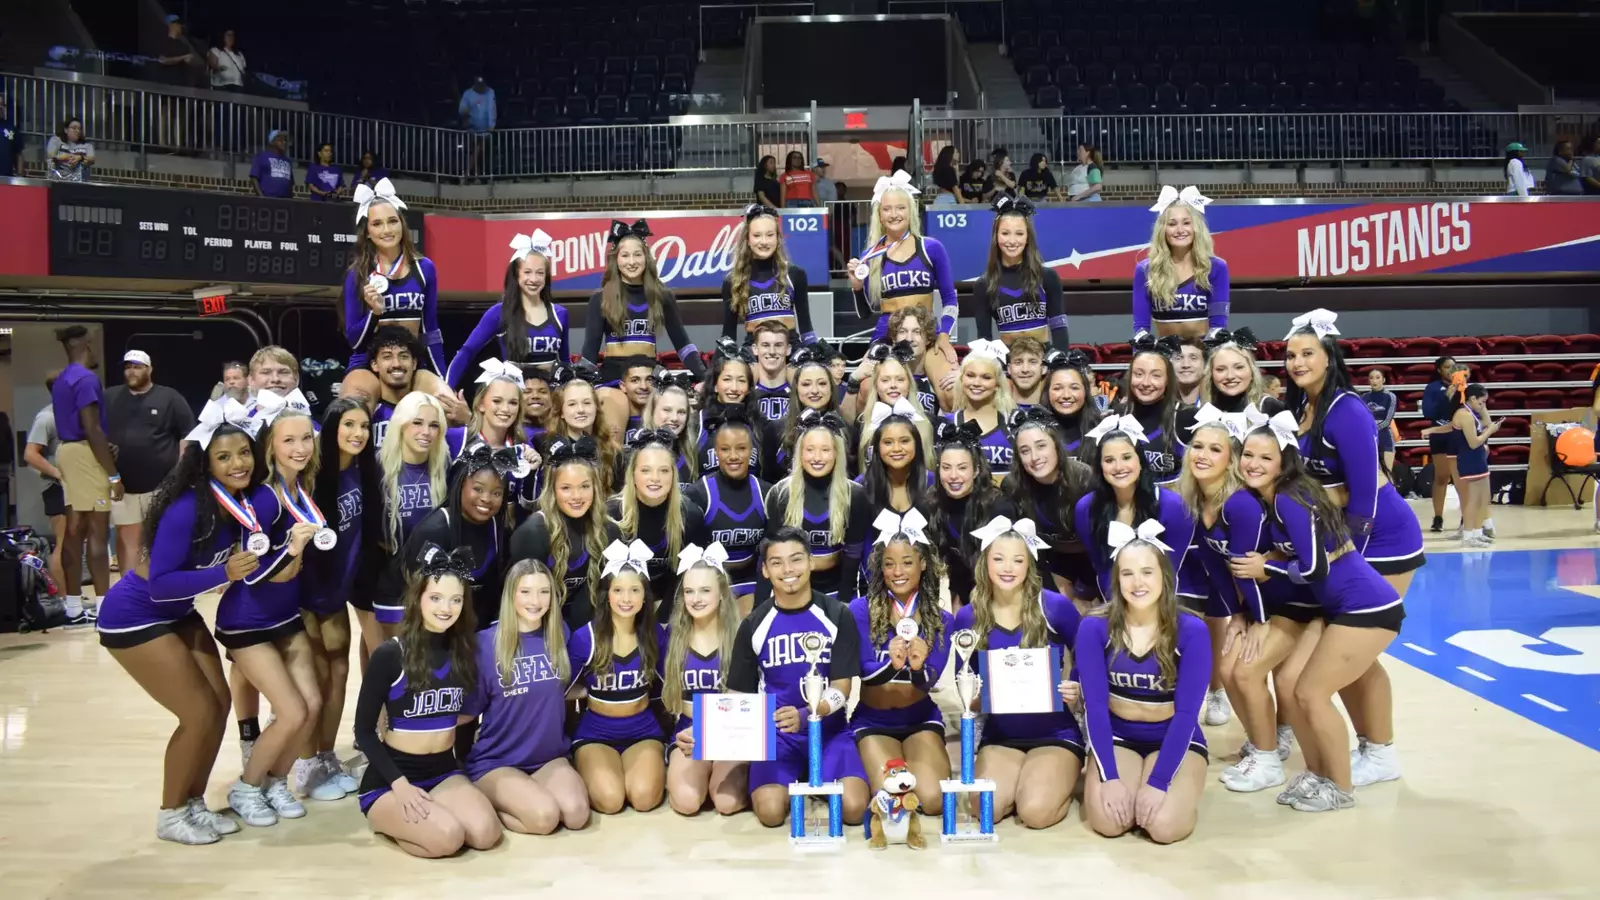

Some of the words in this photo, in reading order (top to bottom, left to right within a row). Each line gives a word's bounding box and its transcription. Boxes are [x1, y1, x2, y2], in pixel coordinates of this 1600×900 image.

[139, 221, 153, 230] SETS
[154, 222, 169, 231] WON
[788, 217, 818, 232] 102
[936, 214, 967, 228] 103
[182, 226, 198, 236] TOL
[333, 233, 346, 242] SETS
[204, 237, 233, 248] PERIOD
[244, 239, 272, 250] PLAYER
[308, 234, 322, 244] TOL
[1297, 202, 1471, 277] MUSTANGS
[280, 241, 299, 252] FOUL
[551, 230, 609, 276] PONY
[650, 221, 746, 283] Dall
[202, 295, 225, 314] EXIT
[382, 291, 426, 312] ACKS
[747, 292, 791, 315] ACKS
[591, 670, 649, 692] JACK
[1108, 671, 1176, 692] JACK
[503, 687, 528, 698] CHEER
[830, 692, 842, 706] SFA
